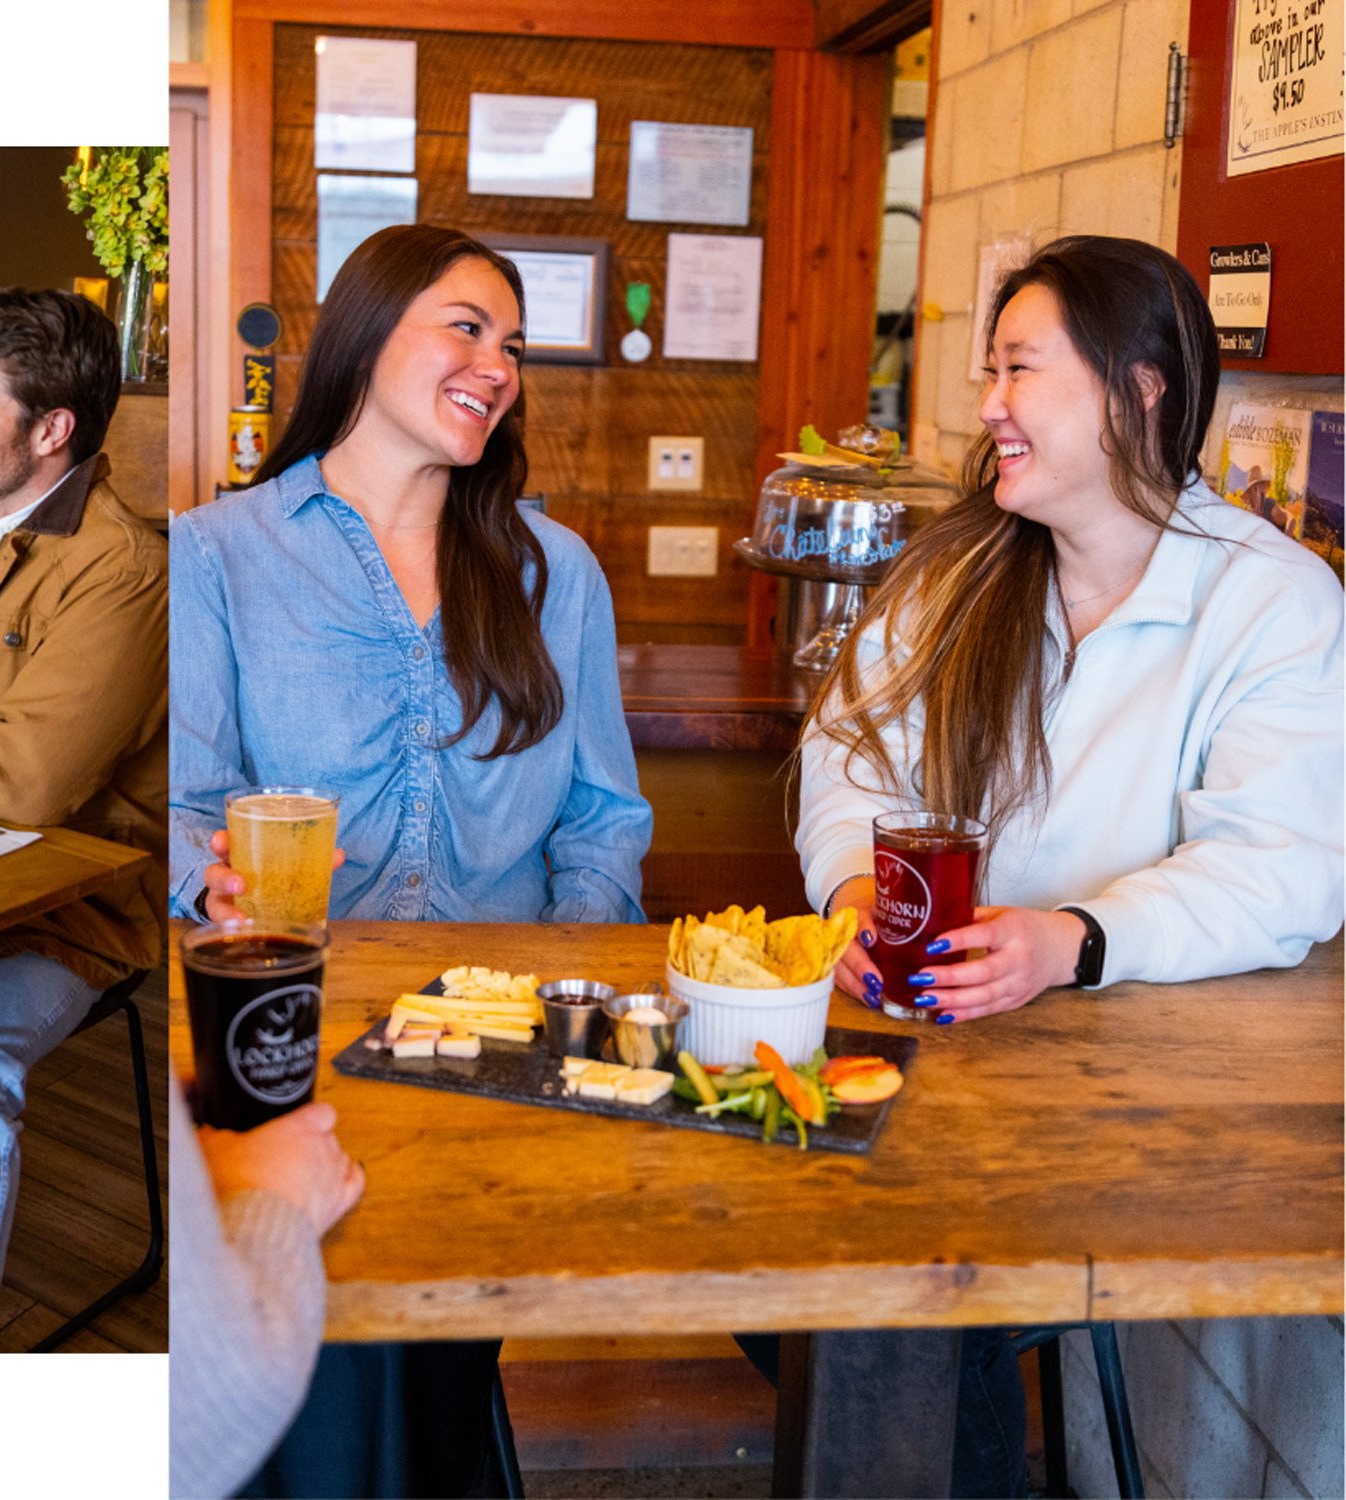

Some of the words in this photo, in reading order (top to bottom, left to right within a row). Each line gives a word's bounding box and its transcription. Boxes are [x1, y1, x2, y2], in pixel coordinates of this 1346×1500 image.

[1250, 18, 1283, 45] above
[1287, 6, 1299, 30] in
[1304, 0, 1326, 21] our
[1258, 22, 1325, 83] SAMPLER
[1272, 78, 1304, 115] $9.50
[1253, 127, 1270, 143] THE
[1243, 249, 1252, 266] &
